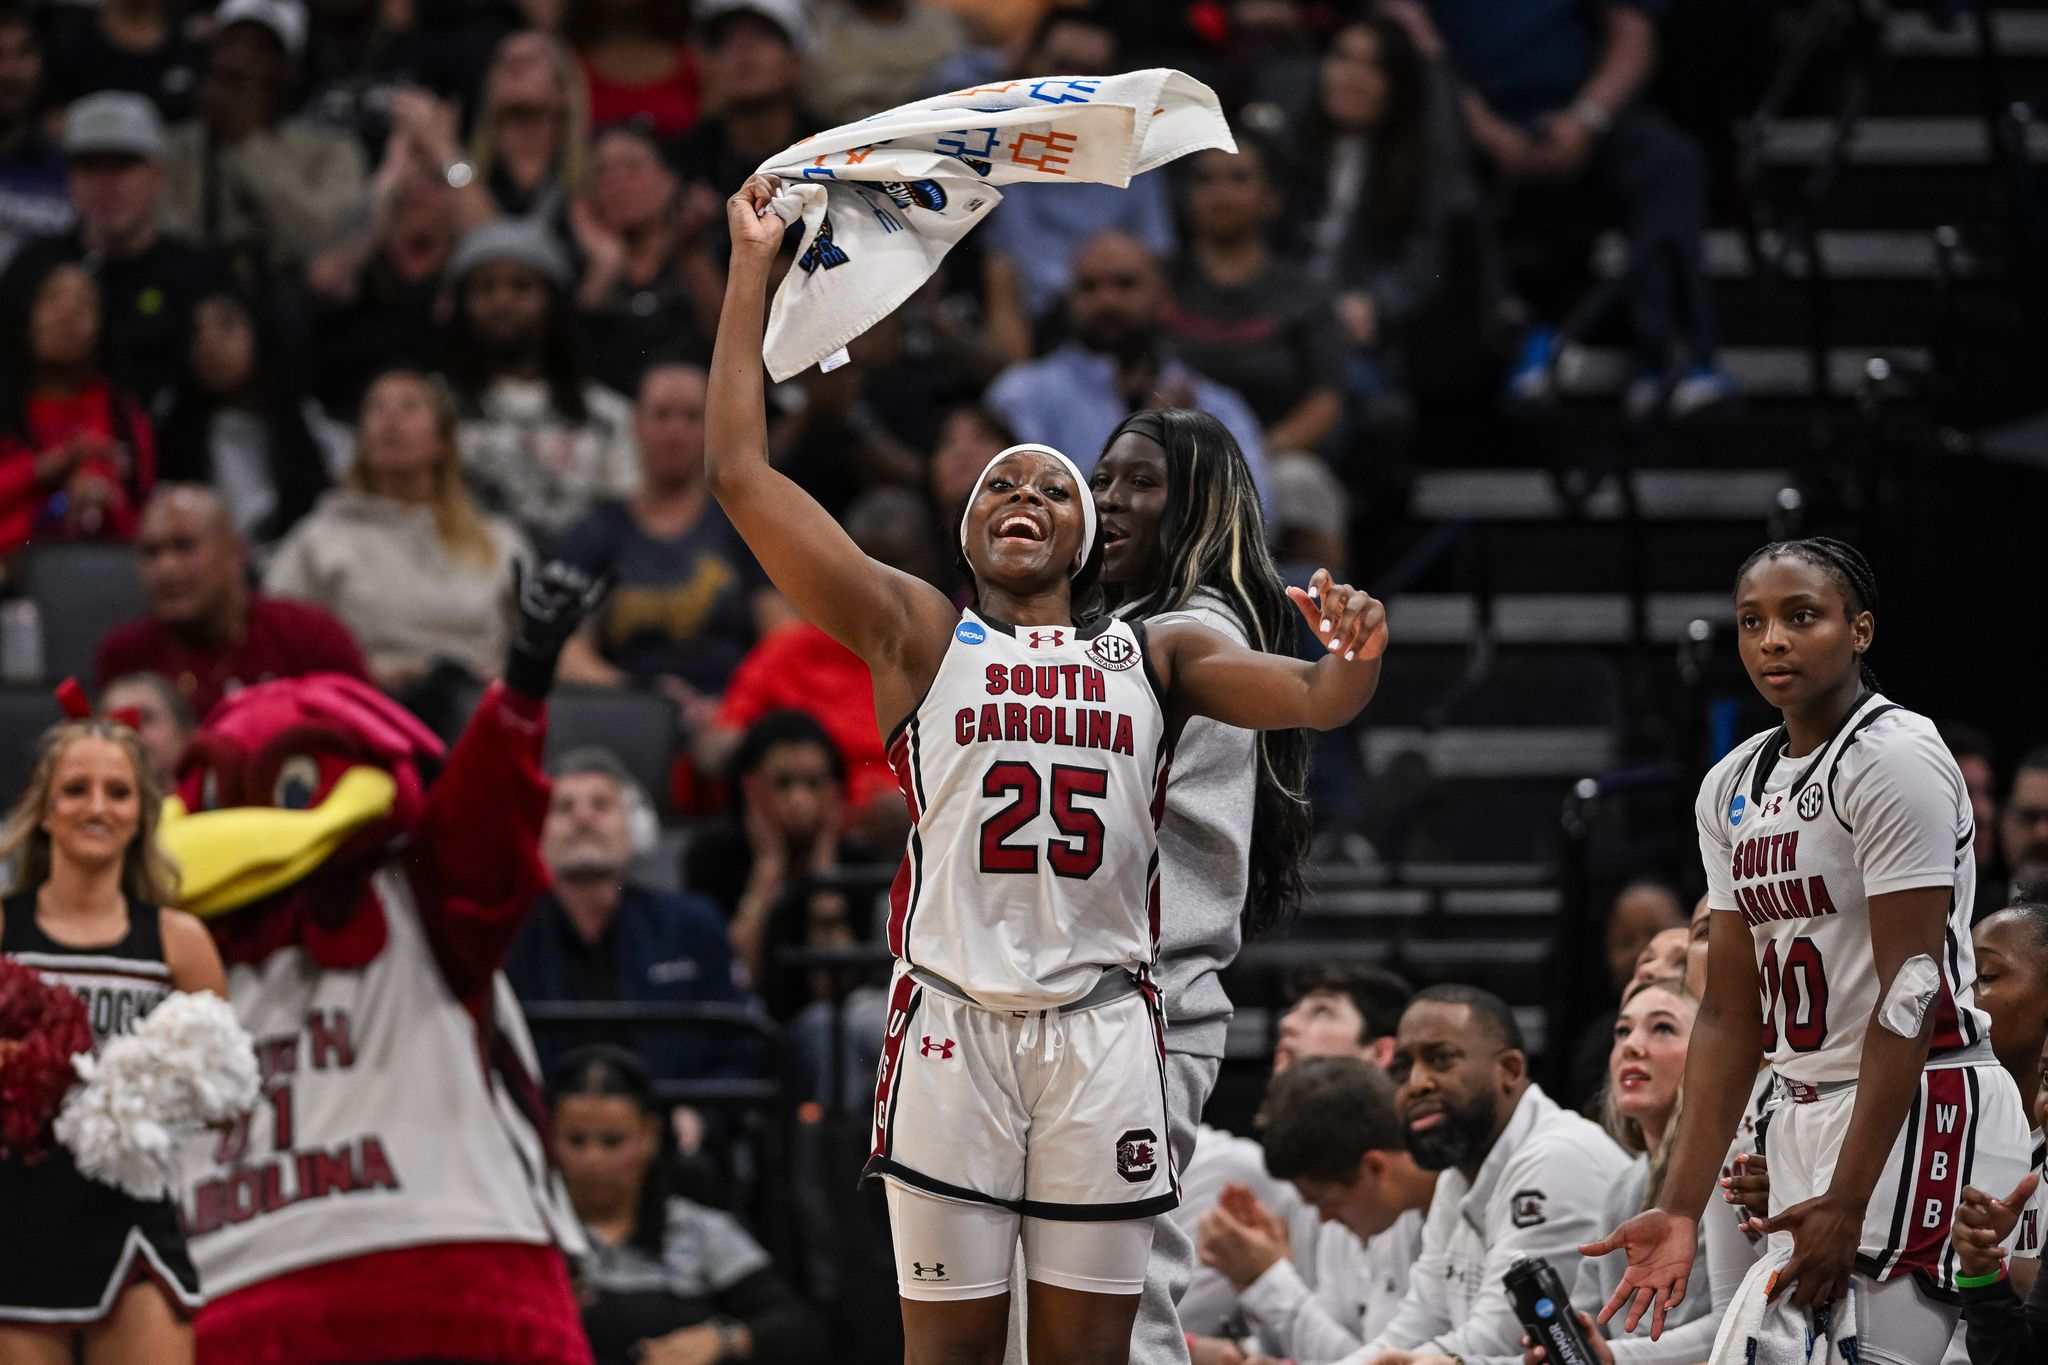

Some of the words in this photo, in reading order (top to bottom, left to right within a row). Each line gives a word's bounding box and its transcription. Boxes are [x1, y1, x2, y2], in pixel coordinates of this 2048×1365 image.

[959, 630, 984, 641] NCAA
[1096, 636, 1130, 661] SEC
[1093, 655, 1135, 670] GRADUATE
[986, 663, 1106, 702] SOUTH
[955, 703, 1134, 756] CAROLINA
[1800, 784, 1821, 818] SEC
[980, 760, 1109, 880] 25
[1732, 830, 1799, 881] SOUTH
